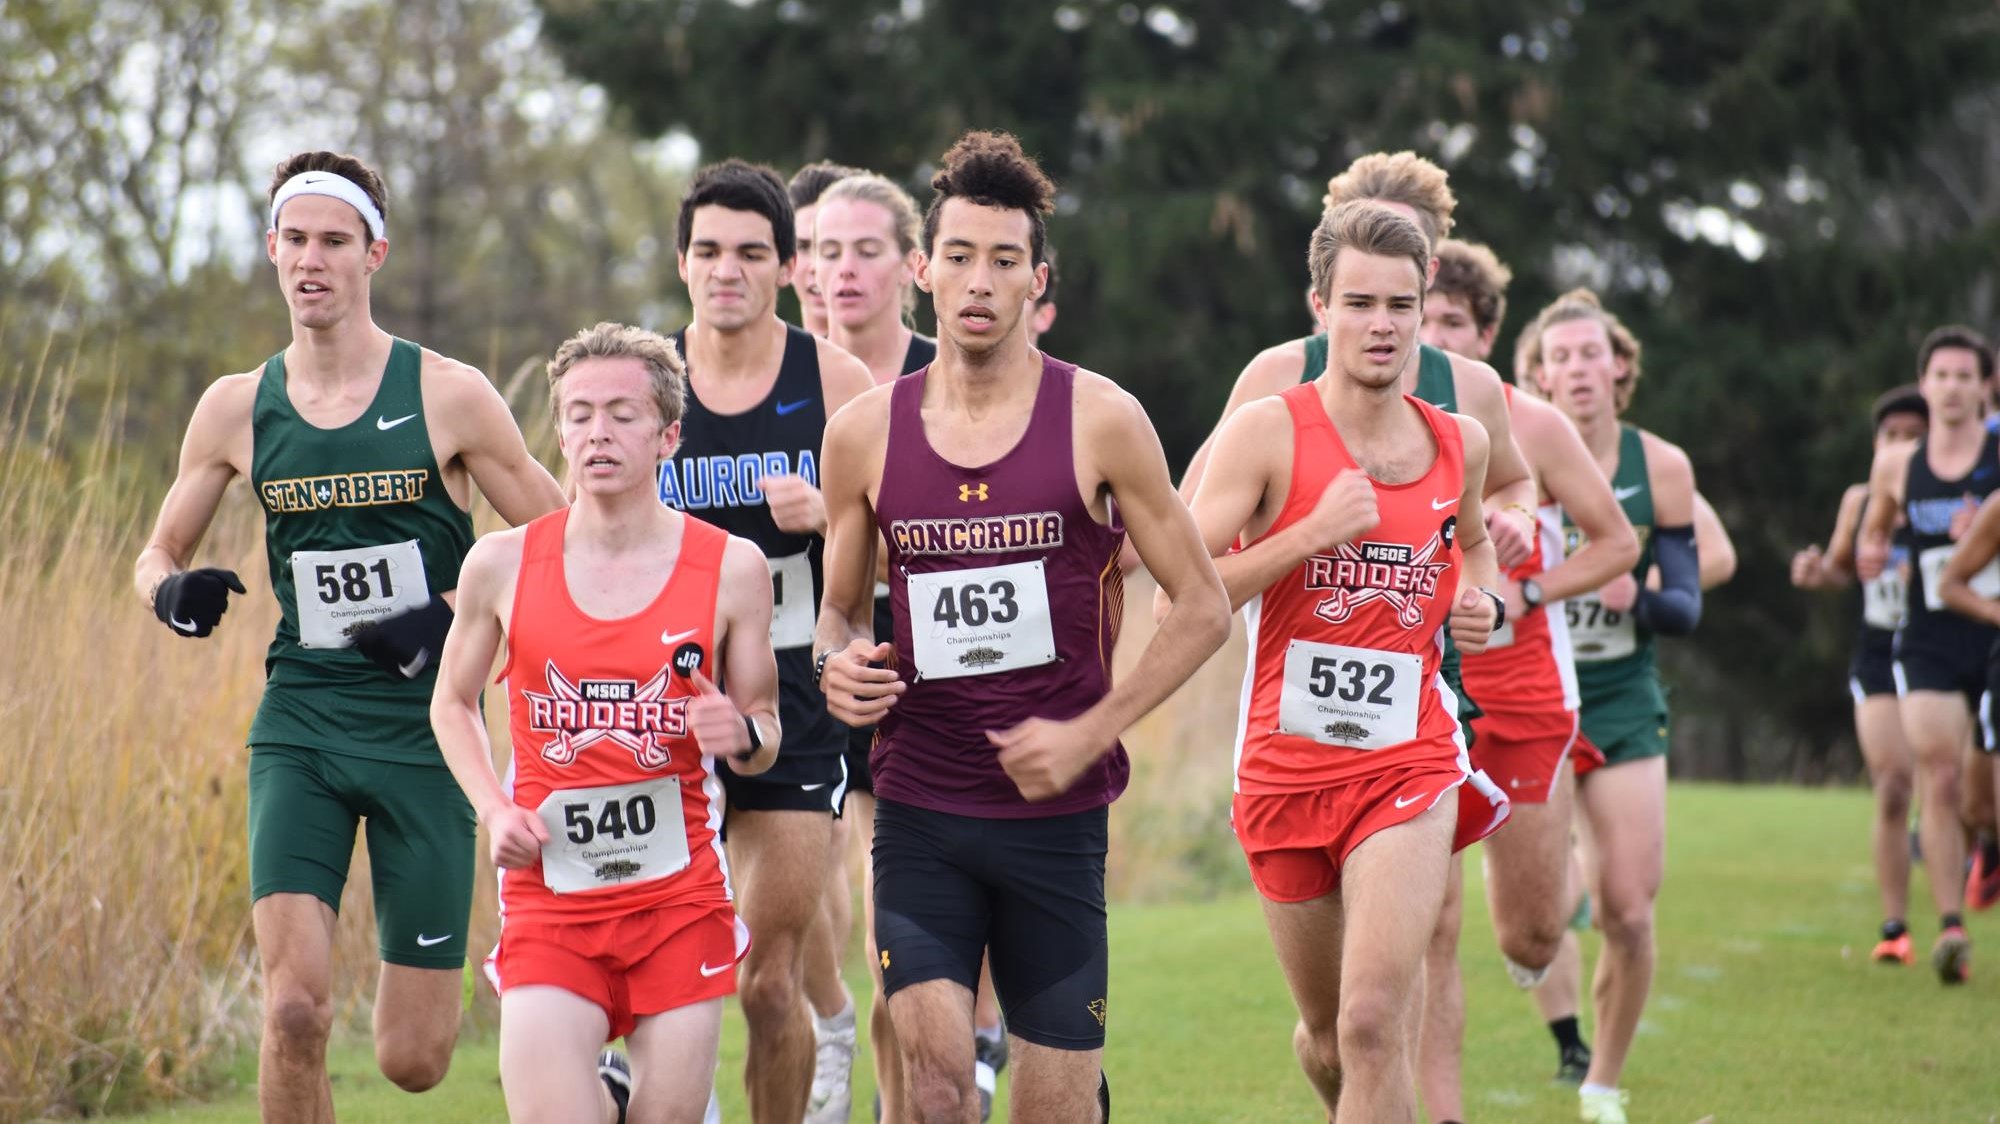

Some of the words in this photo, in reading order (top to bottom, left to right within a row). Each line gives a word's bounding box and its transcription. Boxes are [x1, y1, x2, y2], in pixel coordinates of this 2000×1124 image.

[890, 511, 1064, 555] CONCORDIA
[1366, 546, 1408, 563] MSOE
[315, 558, 394, 604] 581
[1307, 558, 1442, 598] RAIDERS
[331, 606, 392, 618] Championships
[933, 580, 1019, 628] 463
[946, 631, 1012, 646] Championships
[586, 683, 630, 699] MSOE
[1308, 656, 1396, 706] 532
[531, 698, 688, 736] RAIDERS
[1317, 704, 1381, 721] Championships
[564, 794, 656, 844] 540
[581, 843, 648, 860] Championships
